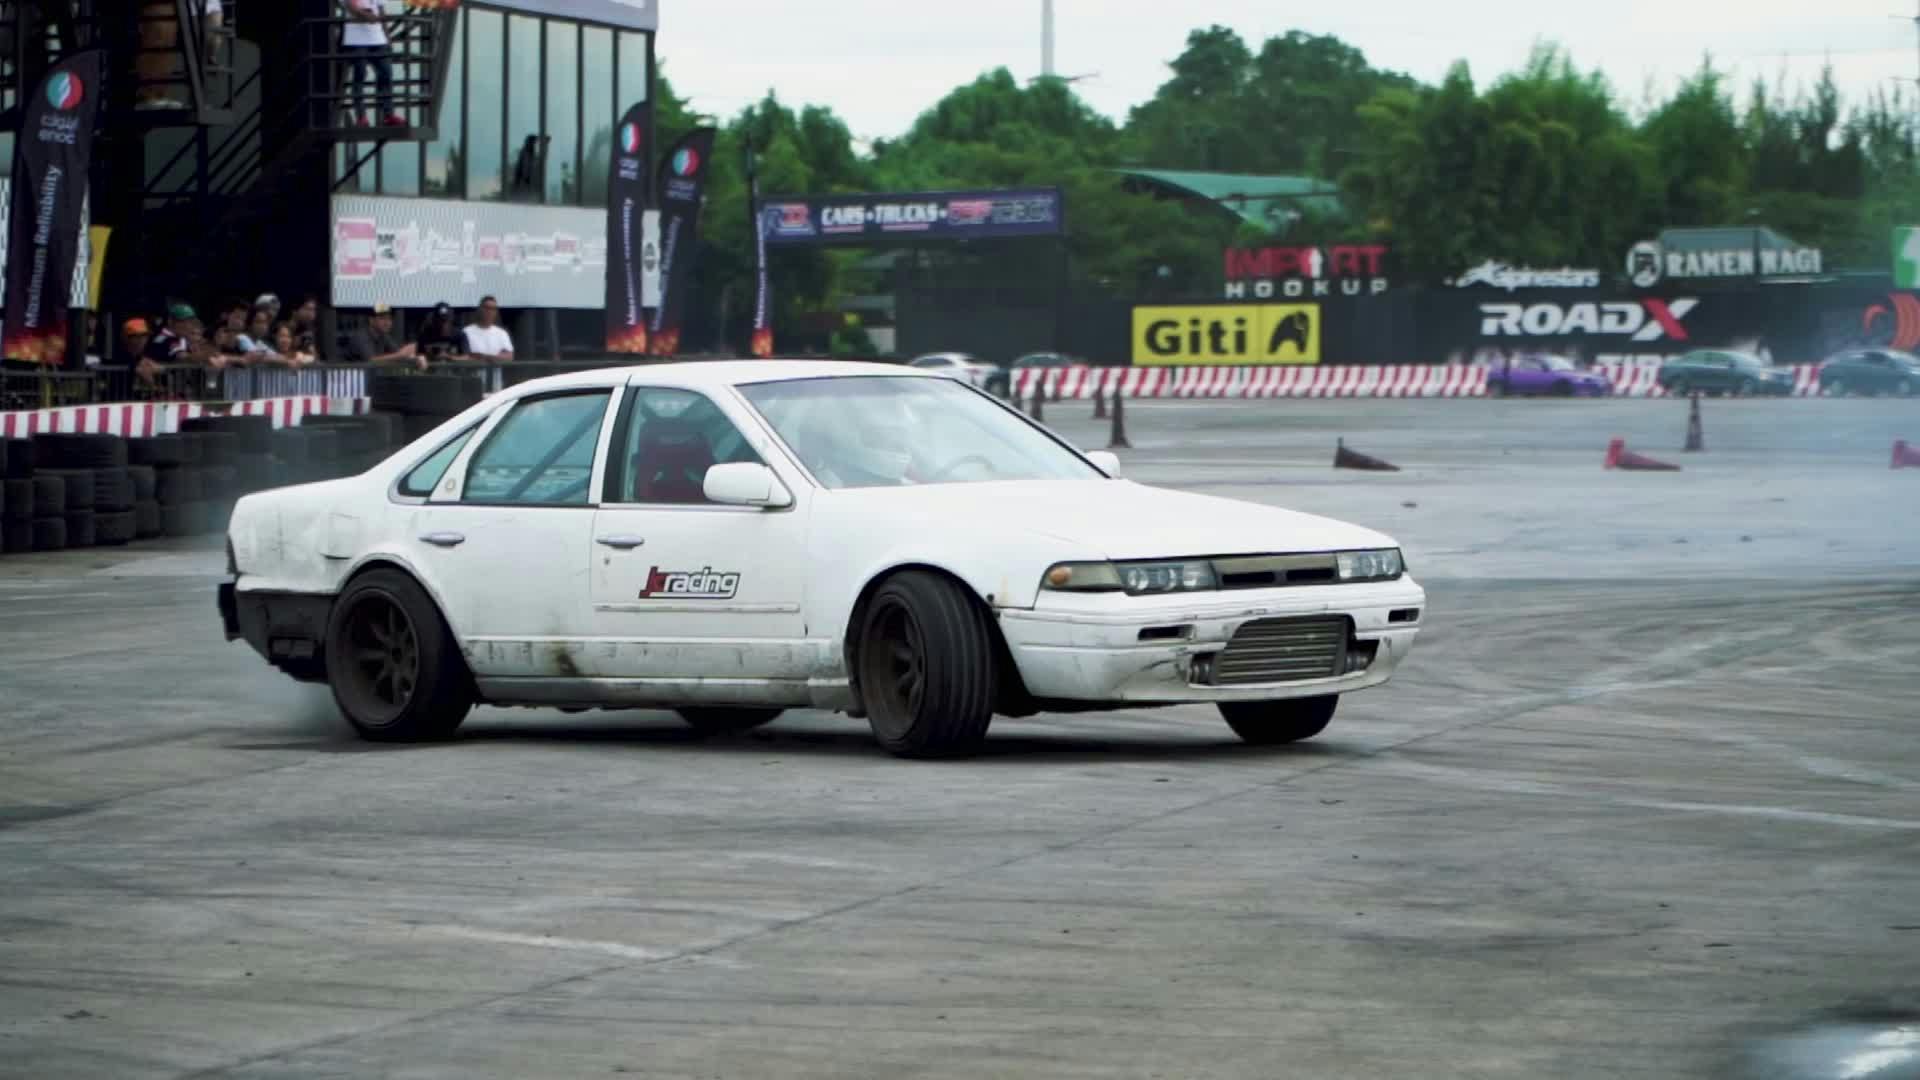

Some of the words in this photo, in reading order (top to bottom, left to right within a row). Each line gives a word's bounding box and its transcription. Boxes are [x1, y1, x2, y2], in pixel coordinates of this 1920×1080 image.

[33, 163, 62, 246] Reliability
[1666, 251, 1754, 277] RAMEN
[1760, 248, 1822, 274] NAGI
[1225, 278, 1388, 298] HOOKUP
[1145, 317, 1247, 355] Giti
[1480, 298, 1698, 341] ROADX
